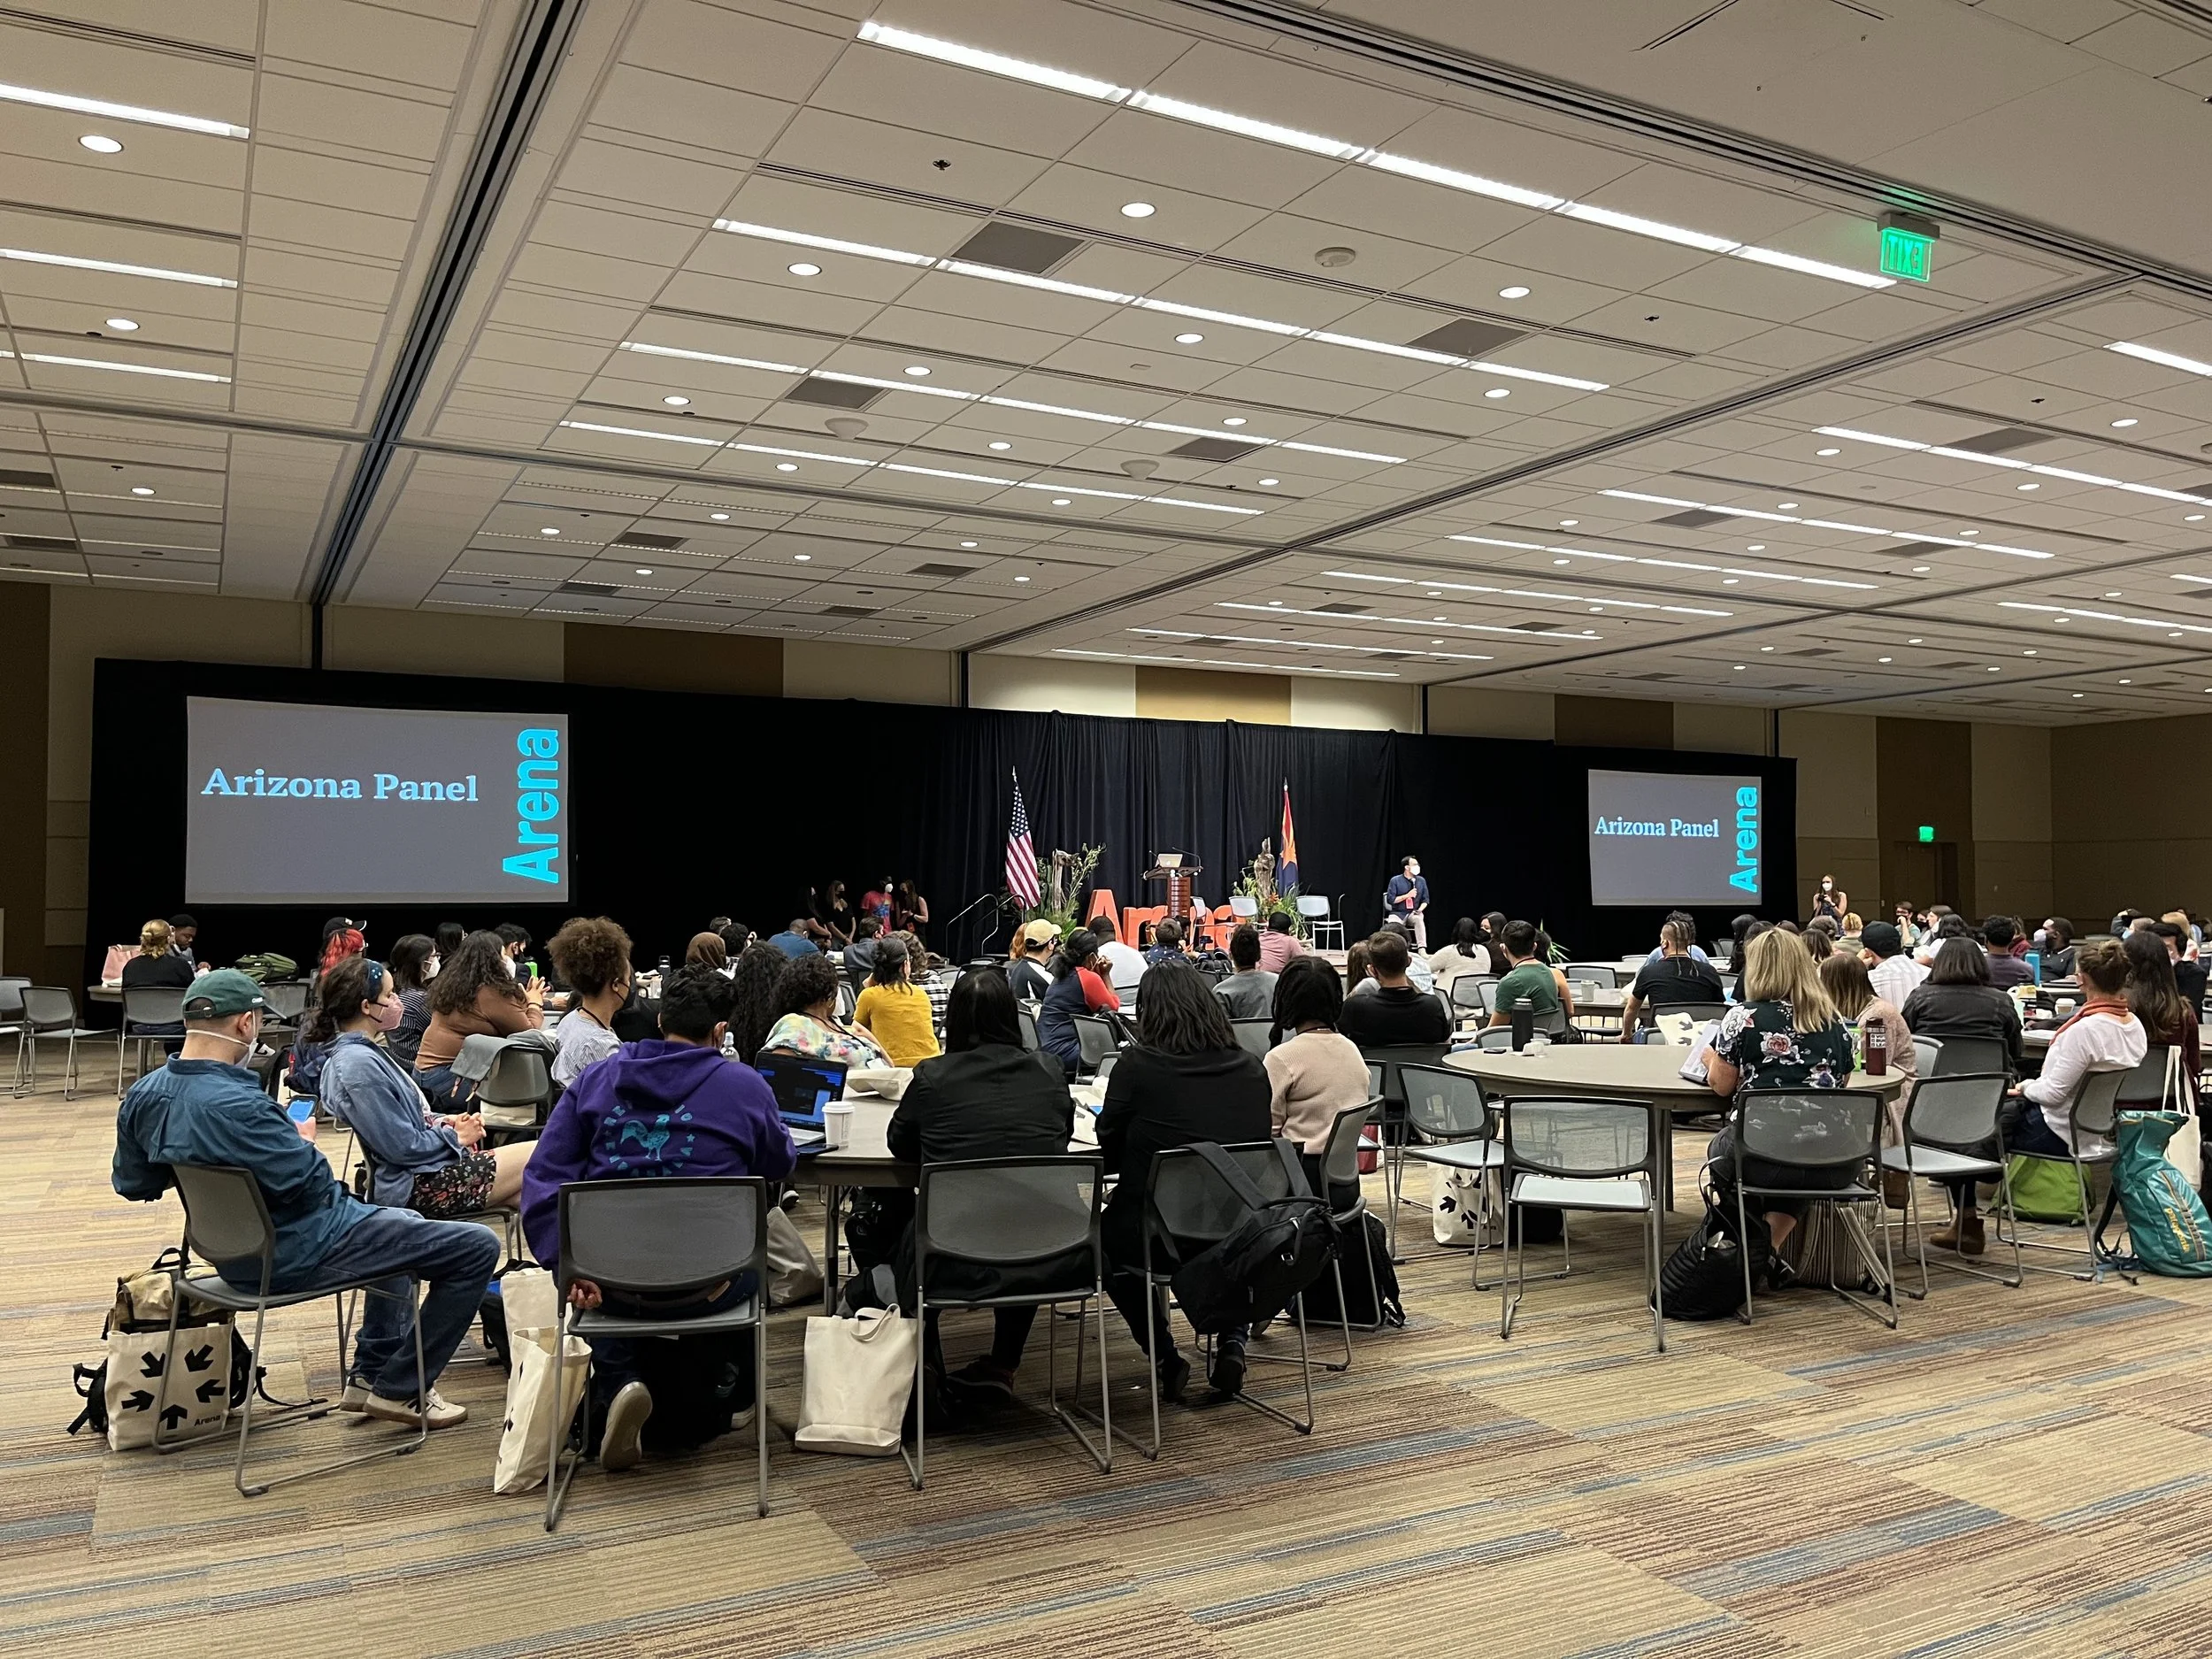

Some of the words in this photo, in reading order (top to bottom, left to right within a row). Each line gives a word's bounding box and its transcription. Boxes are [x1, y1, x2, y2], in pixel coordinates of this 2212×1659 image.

[201, 767, 362, 799] Arizona
[373, 772, 479, 803] Panel
[502, 727, 560, 884] Arena
[1594, 816, 1666, 836] Arizona
[1670, 818, 1719, 838] Panel
[1729, 787, 1757, 894] Arena
[194, 1415, 220, 1426] Arena
